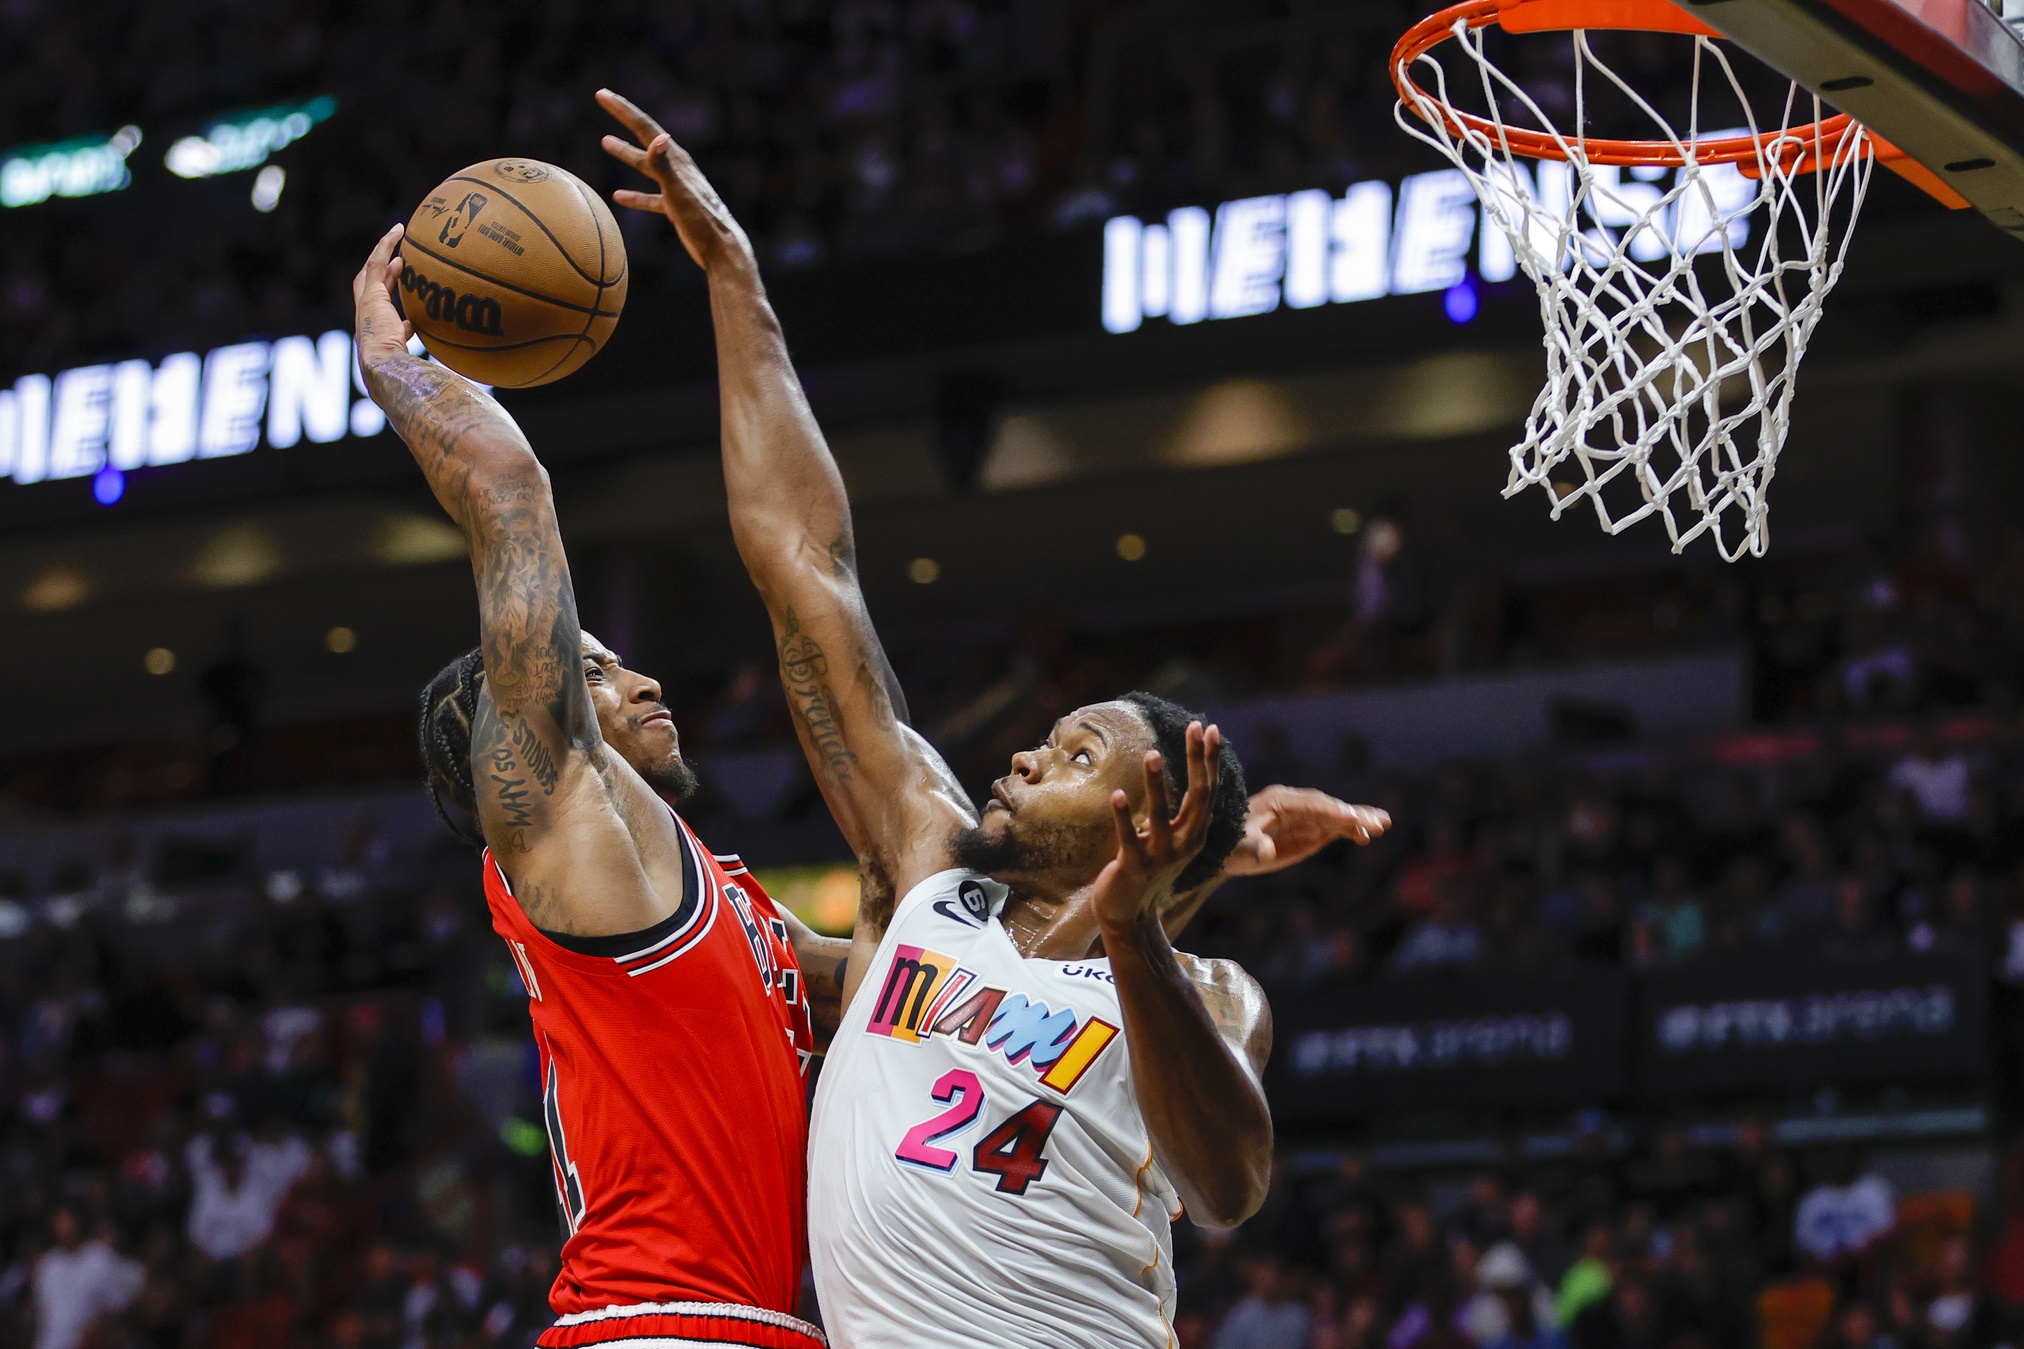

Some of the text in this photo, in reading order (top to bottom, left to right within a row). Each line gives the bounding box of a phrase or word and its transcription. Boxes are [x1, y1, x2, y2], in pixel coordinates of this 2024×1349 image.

[400, 260, 505, 338] Wilso
[492, 748, 516, 773] SO
[491, 774, 533, 827] WHY
[865, 944, 1121, 1096] MIAMI
[895, 1068, 1065, 1196] 24
